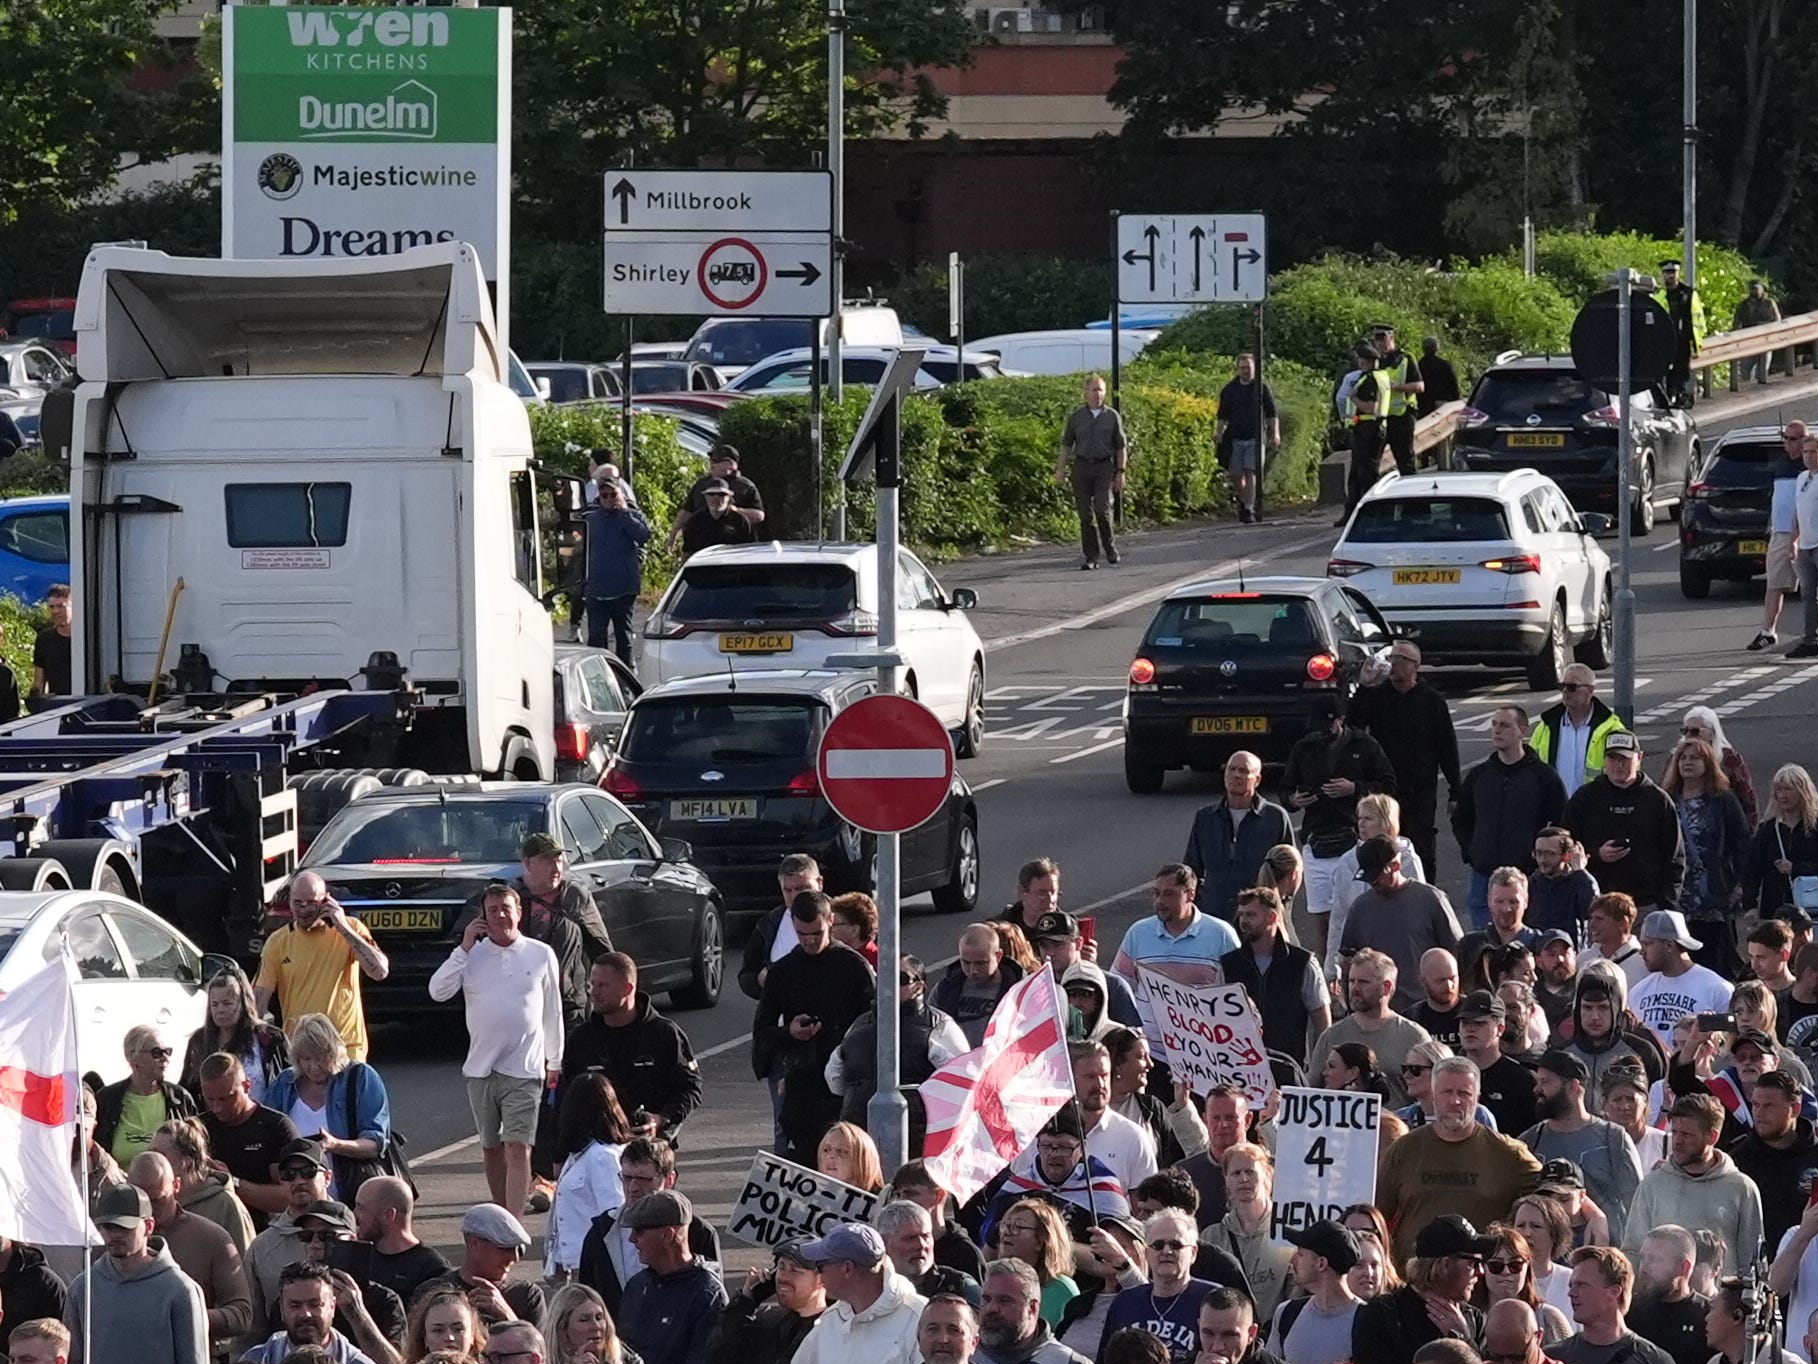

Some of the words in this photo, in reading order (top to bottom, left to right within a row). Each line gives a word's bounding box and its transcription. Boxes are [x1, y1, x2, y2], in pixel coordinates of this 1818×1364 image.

[287, 10, 449, 47] wren
[307, 53, 427, 70] KITCHENS
[299, 95, 430, 130] Dunelm
[647, 192, 752, 211] Millbrook
[613, 263, 690, 285] Shirley
[1743, 541, 1769, 552] HK7
[1397, 571, 1429, 583] HK72
[725, 636, 754, 648] EP17
[758, 635, 784, 648] GCX
[1197, 719, 1231, 731] DV06
[681, 803, 713, 816] MF14
[718, 802, 748, 816] LVA
[360, 910, 400, 928] KU60
[407, 909, 441, 928] DZN
[1149, 982, 1244, 1018] HENRYS
[1639, 993, 1697, 1013] GYMSHARK
[1167, 1007, 1234, 1044] BLOOD
[1177, 1031, 1234, 1069] YOUR
[1279, 1093, 1380, 1130] JUSTICE
[1304, 1136, 1334, 1177] 4
[740, 1182, 849, 1237] POLIC
